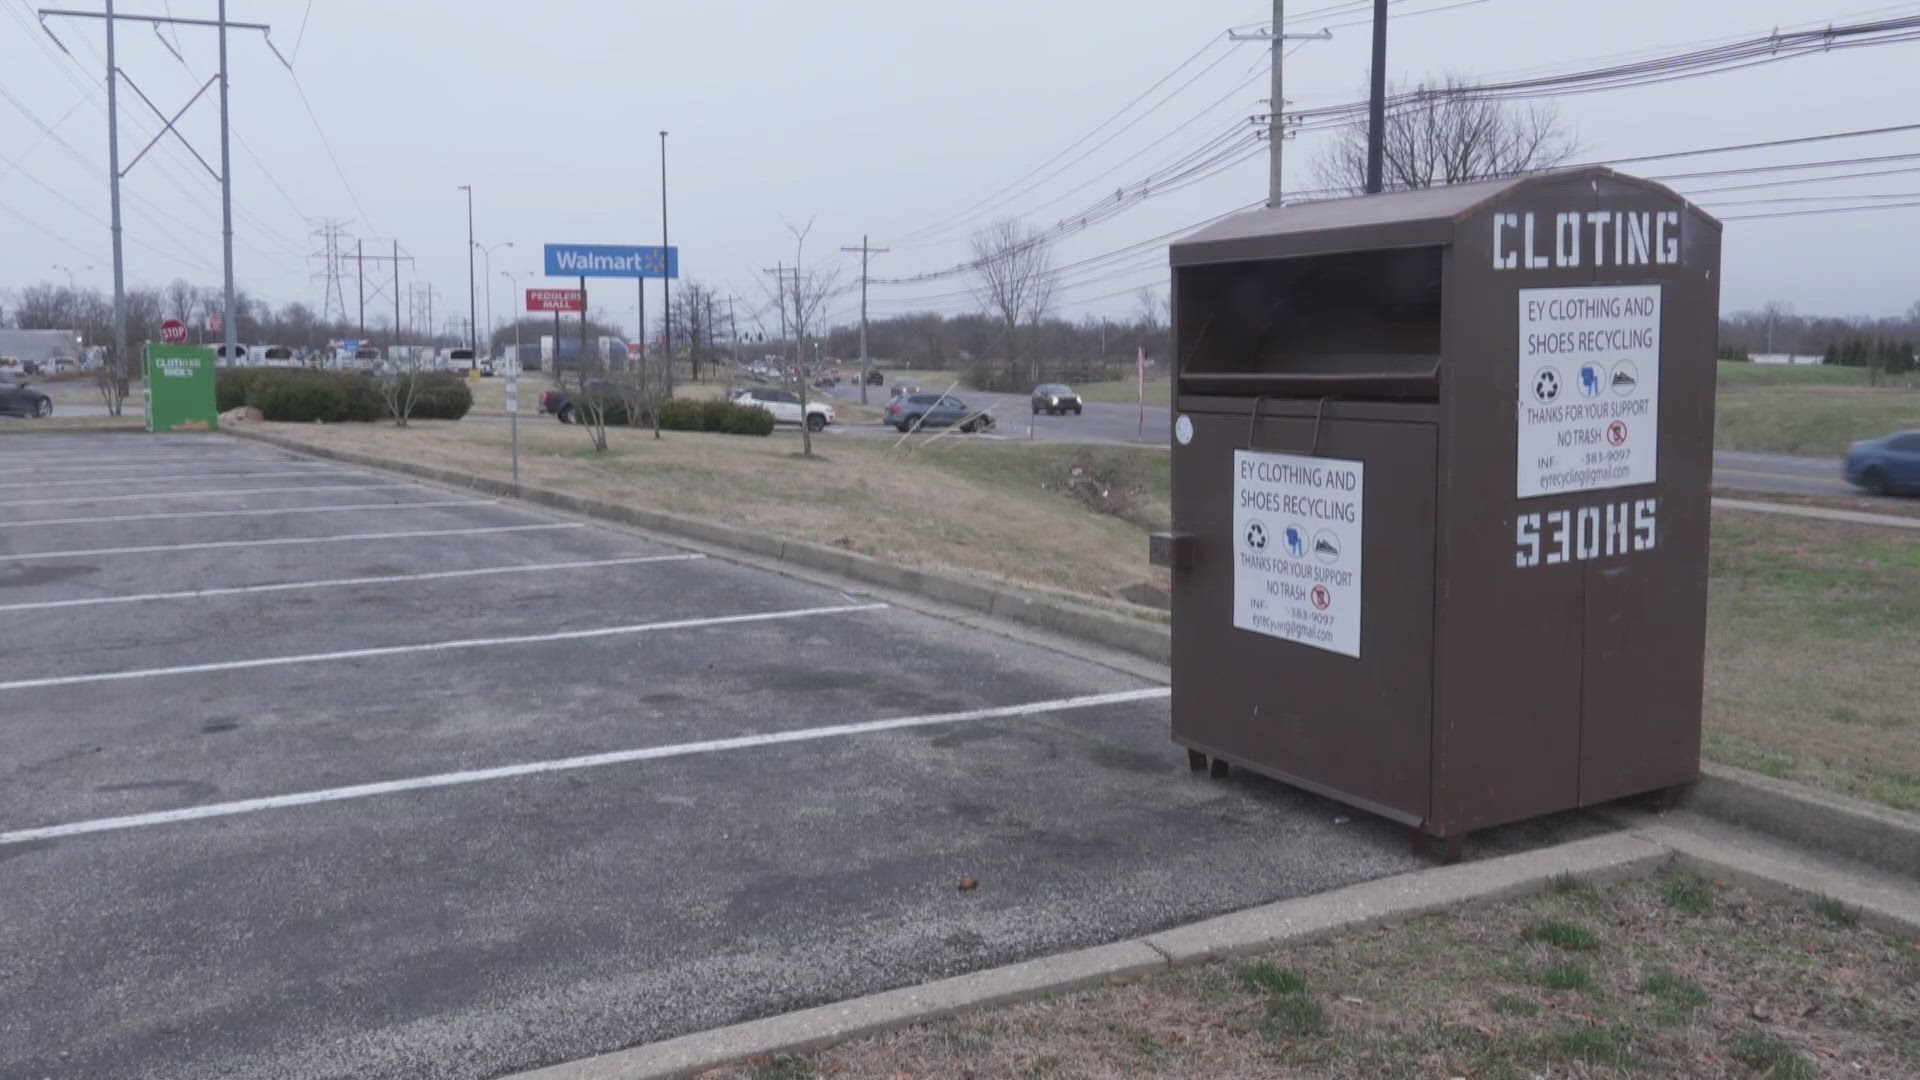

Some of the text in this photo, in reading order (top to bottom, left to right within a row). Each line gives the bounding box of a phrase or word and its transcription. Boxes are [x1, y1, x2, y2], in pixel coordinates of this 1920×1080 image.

[1493, 211, 1679, 269] CLOTING
[556, 251, 642, 271] Walmart
[543, 300, 570, 309] MALL
[1528, 296, 1654, 321] EY CLOTHING AND
[162, 327, 184, 338] STOP
[1528, 328, 1653, 355] SHOES RECYCLING
[1527, 399, 1649, 425] THANKS FOR YOUR SUPPORT
[1557, 428, 1602, 447] NO TRASH
[1241, 460, 1356, 491] EY CLOTHING AND
[1540, 464, 1630, 491] eyrecycling@gmail.com
[1241, 489, 1355, 523] SHOES RECYCLING
[1241, 552, 1353, 587] THANKS FOR YOUR SUPPORT
[1267, 580, 1307, 601] NO TRASH
